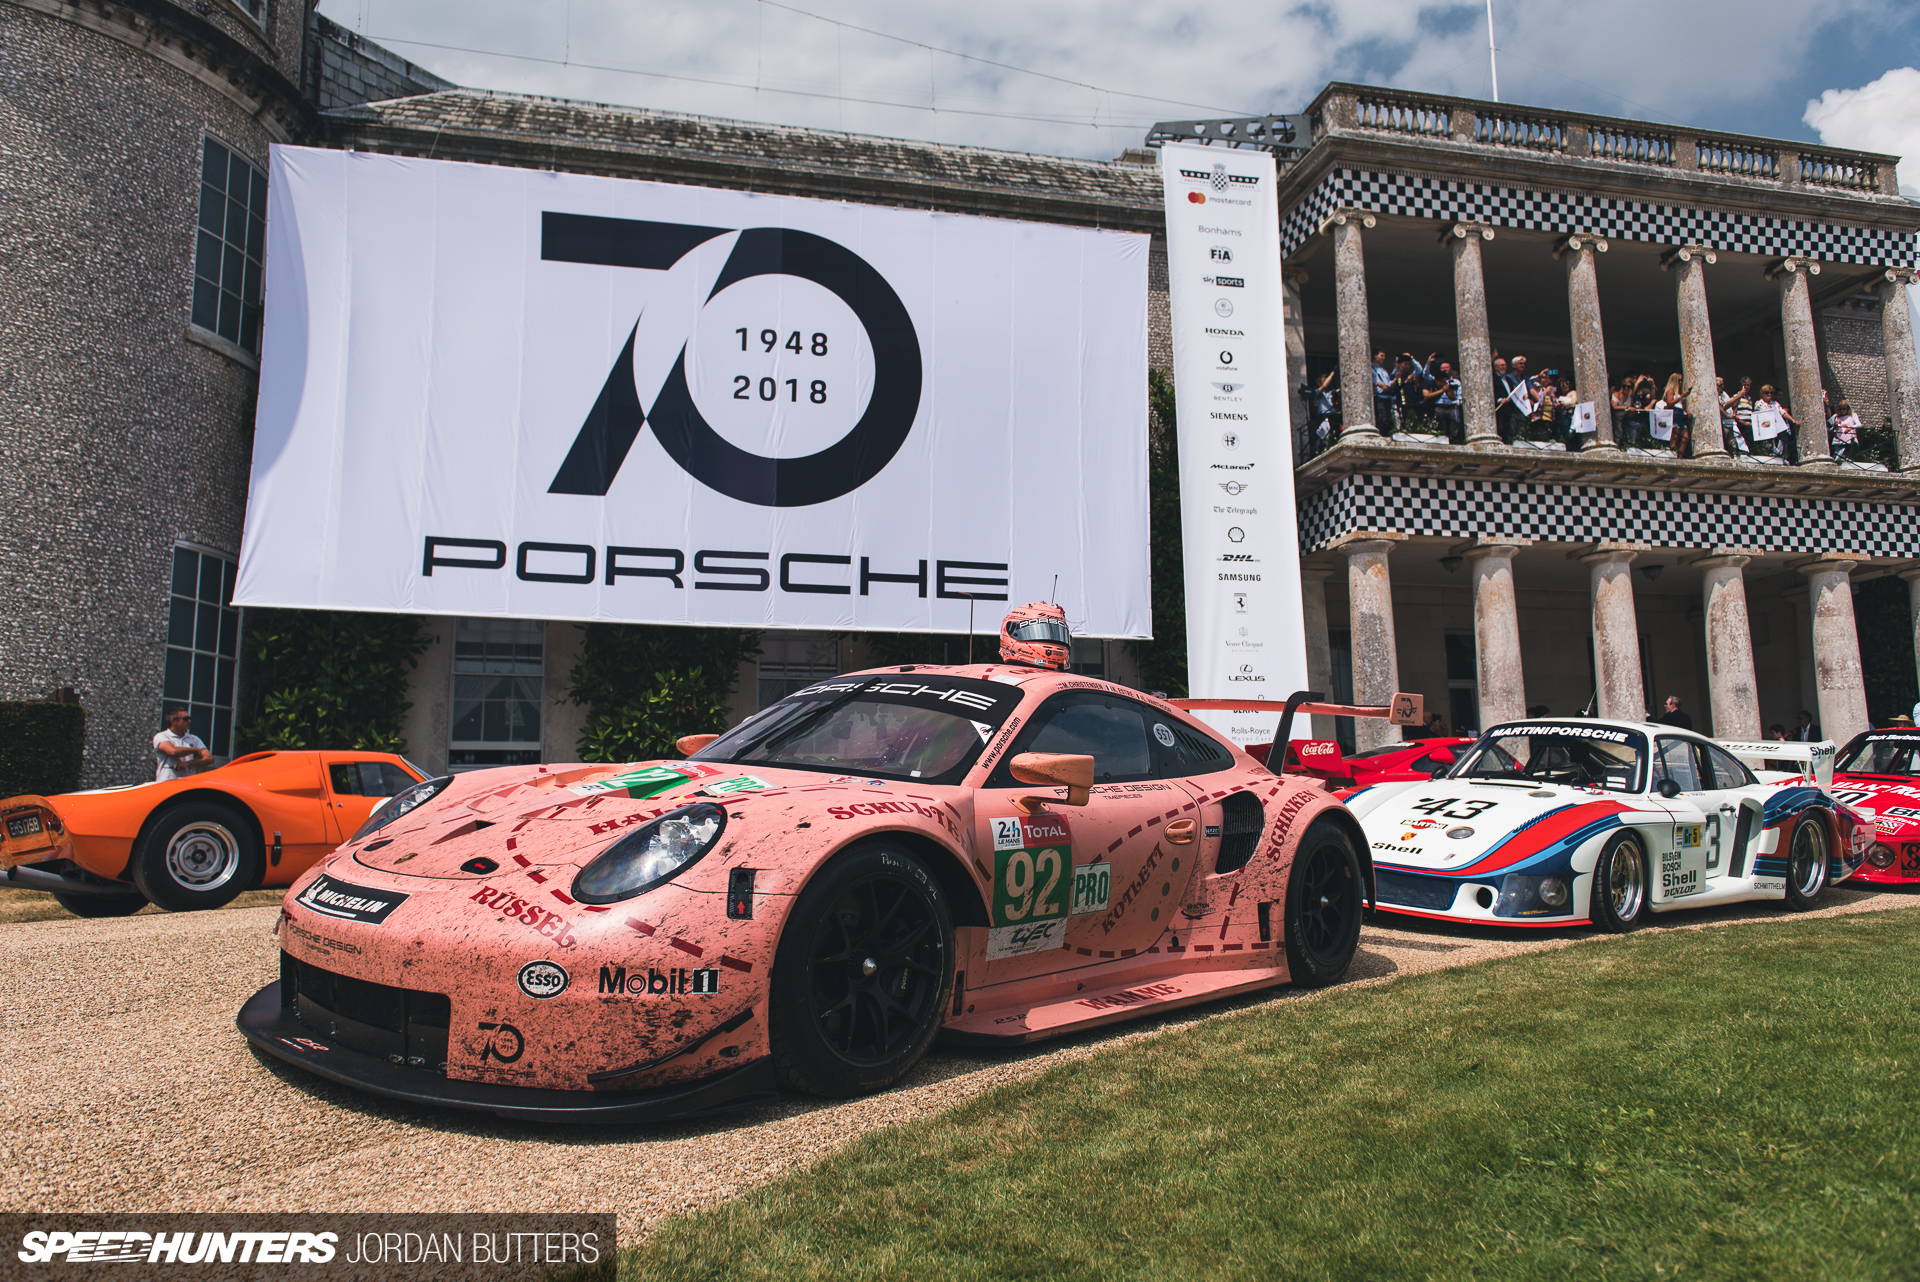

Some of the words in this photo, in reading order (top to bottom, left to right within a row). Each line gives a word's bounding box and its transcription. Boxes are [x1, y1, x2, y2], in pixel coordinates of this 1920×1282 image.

[1209, 196, 1252, 206] mastercard
[1198, 225, 1242, 237] Bonhams
[1203, 276, 1215, 284] sky
[1217, 278, 1243, 287] sports
[1205, 328, 1244, 336] HONDA
[735, 327, 829, 357] 1948
[541, 210, 923, 508] 70
[733, 375, 828, 404] 2018
[1210, 412, 1249, 421] SIEMENS
[1227, 506, 1257, 515] Telegraph
[422, 535, 1009, 602] PORSCHE
[1218, 573, 1261, 581] SAMSUNG
[784, 683, 998, 711] ORSCHE
[1231, 726, 1271, 736] Rolls-Royce
[981, 716, 1021, 769] www.porsche.com
[1810, 745, 1837, 757] Shell
[1123, 784, 1172, 792] DESIGN
[1411, 798, 1499, 819] 43
[998, 821, 1020, 839] 24h
[1024, 825, 1067, 838] TOTAL
[1266, 789, 1320, 863] SCHINKEN
[1400, 819, 1448, 830] MARTINI
[1372, 842, 1423, 854] Shell
[1662, 851, 1682, 862] BILSTEIN
[1662, 861, 1682, 873] BOSCH
[1004, 848, 1062, 921] 92
[1662, 869, 1697, 887] Shell
[1073, 870, 1109, 908] PRO
[1100, 841, 1165, 936] KOTLETT
[1663, 884, 1697, 897] DUNLOP
[316, 889, 389, 913] MICHELIN
[469, 885, 577, 948] RÜSSEL
[289, 923, 322, 943] PORSCHE
[322, 936, 362, 955] DESIGN
[598, 967, 685, 994] Mobil
[1074, 983, 1183, 1011] WAMME
[478, 1021, 525, 1065] 70
[466, 1064, 537, 1079] PORSCHE
